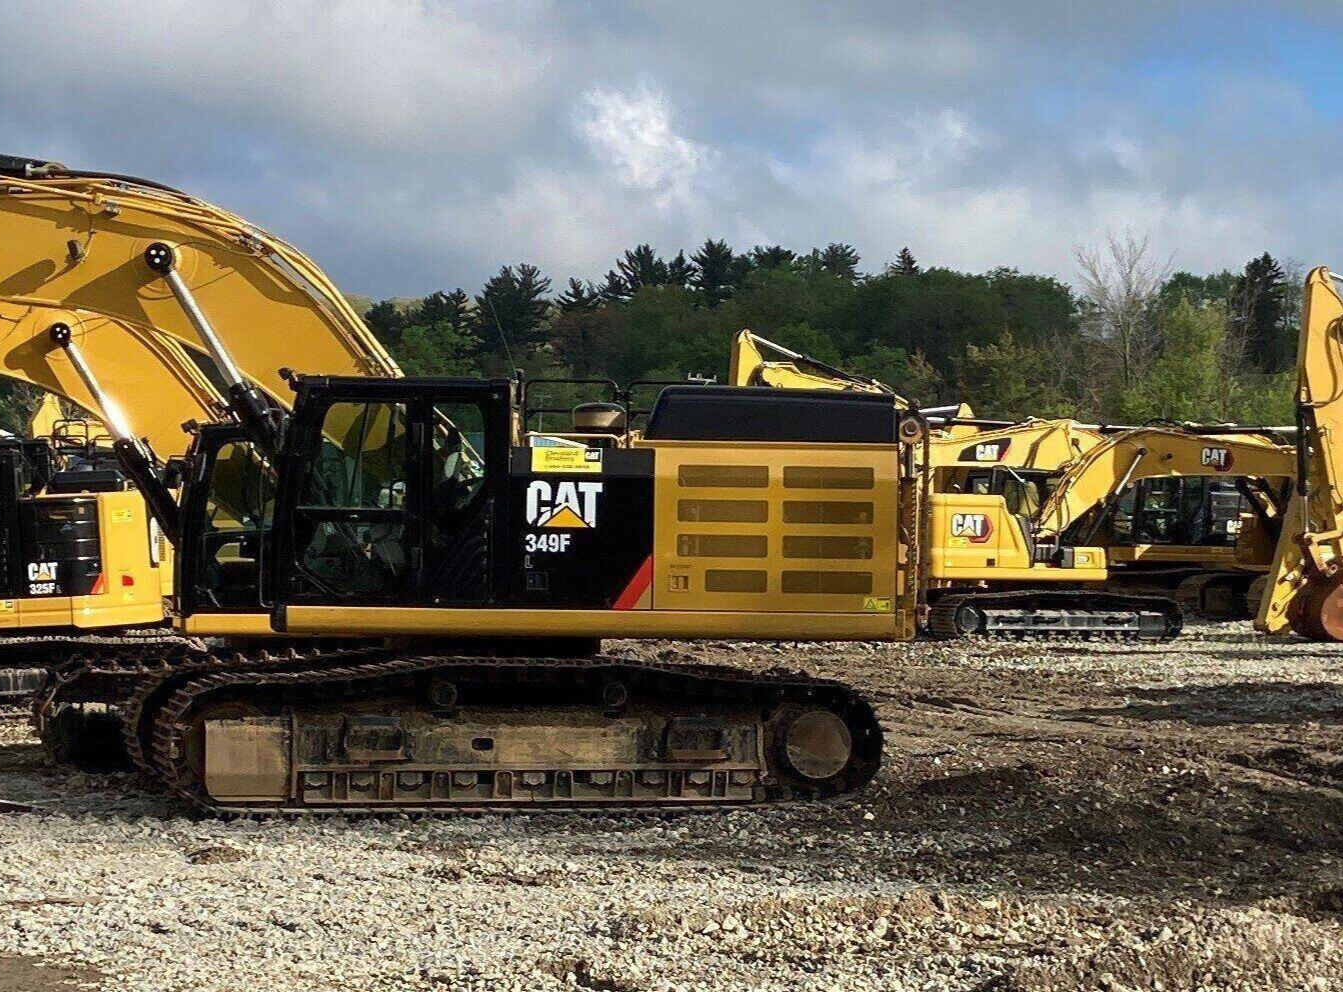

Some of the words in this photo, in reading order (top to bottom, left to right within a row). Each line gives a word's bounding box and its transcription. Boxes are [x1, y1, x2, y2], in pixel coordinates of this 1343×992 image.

[585, 452, 600, 460] CAT
[976, 444, 1000, 461] CAT
[1202, 448, 1228, 467] CAT
[526, 480, 604, 528] CAT
[952, 514, 985, 537] CAT
[525, 533, 571, 552] 349F
[27, 562, 58, 581] CAT
[29, 583, 56, 595] 325F
